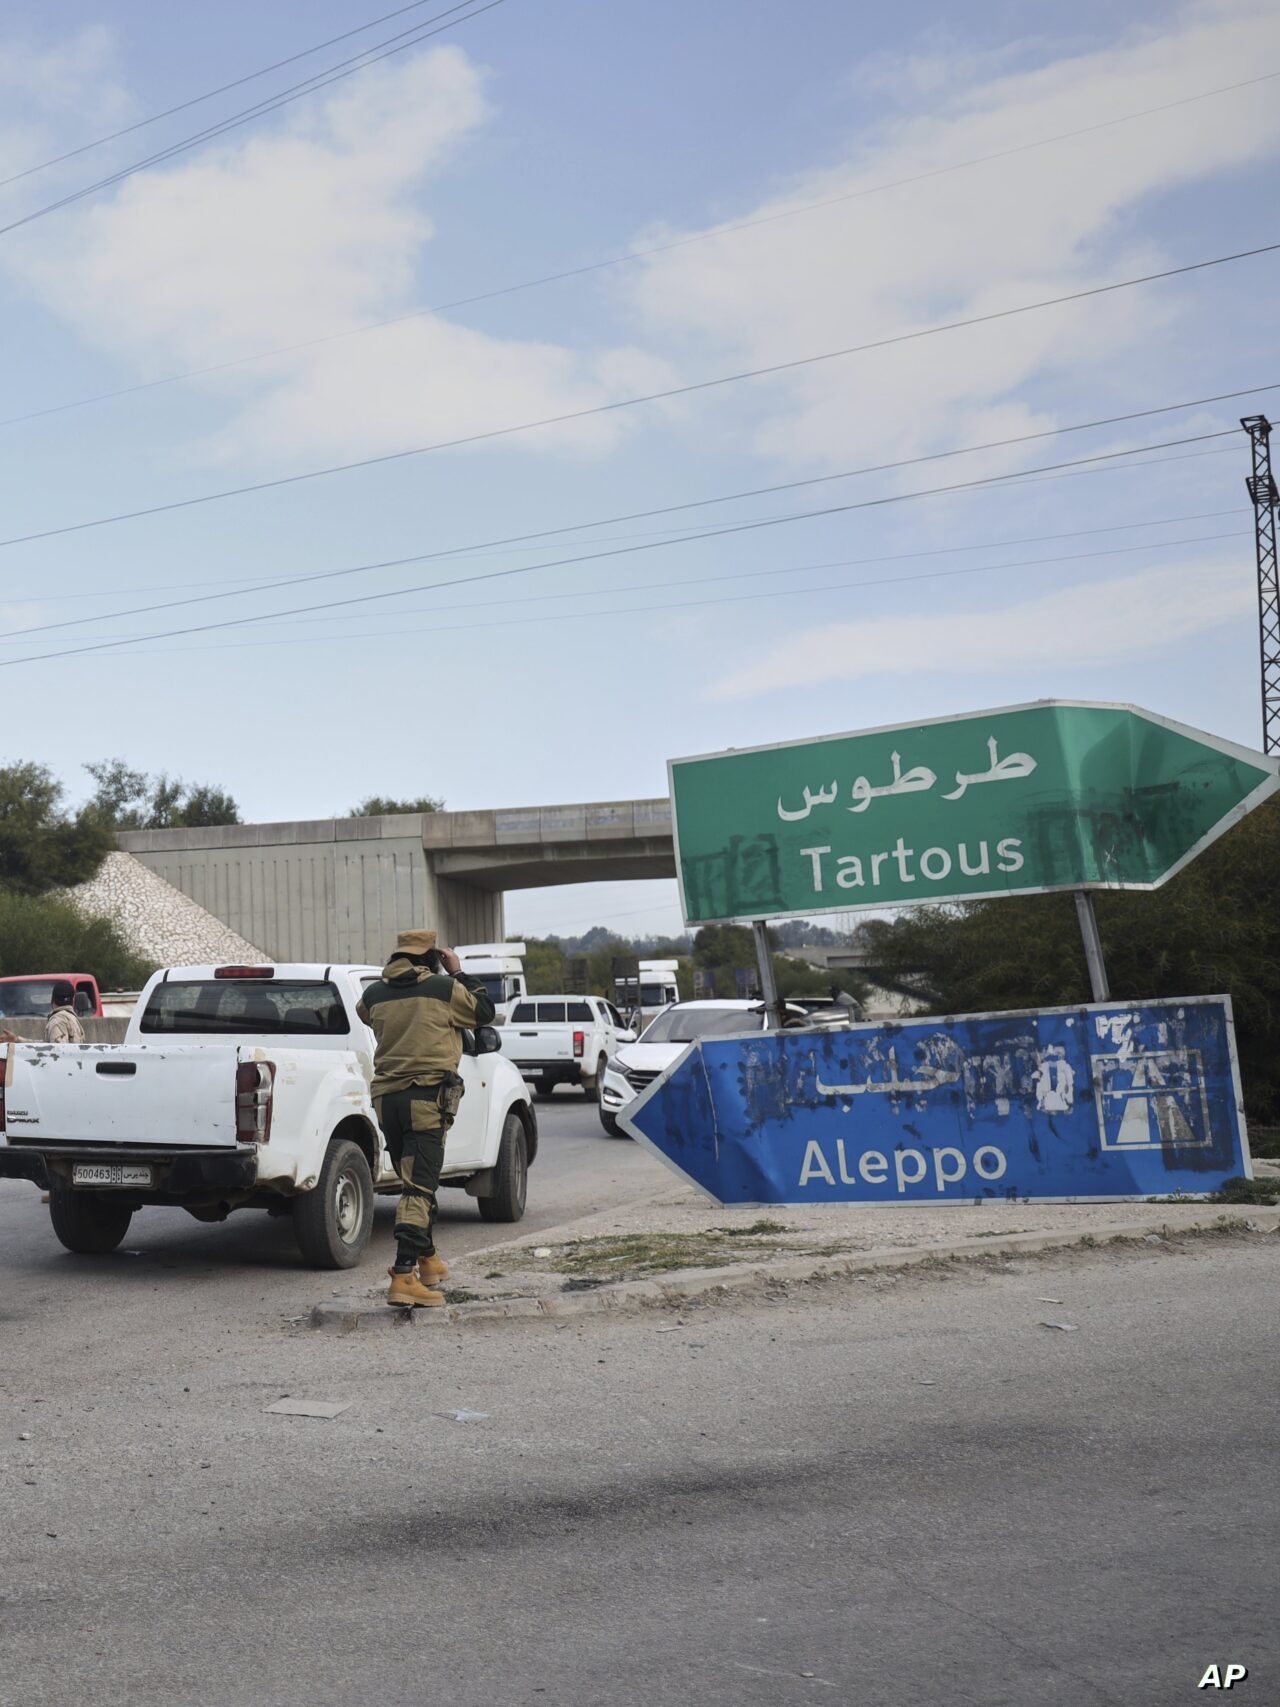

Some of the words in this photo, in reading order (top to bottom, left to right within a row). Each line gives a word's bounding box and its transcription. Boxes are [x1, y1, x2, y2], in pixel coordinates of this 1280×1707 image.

[777, 735, 1038, 821] طرطوس
[799, 837, 1025, 892] Tartous
[816, 1046, 961, 1113] حلب
[77, 1168, 111, 1179] 500463
[798, 1138, 1008, 1193] Aleppo
